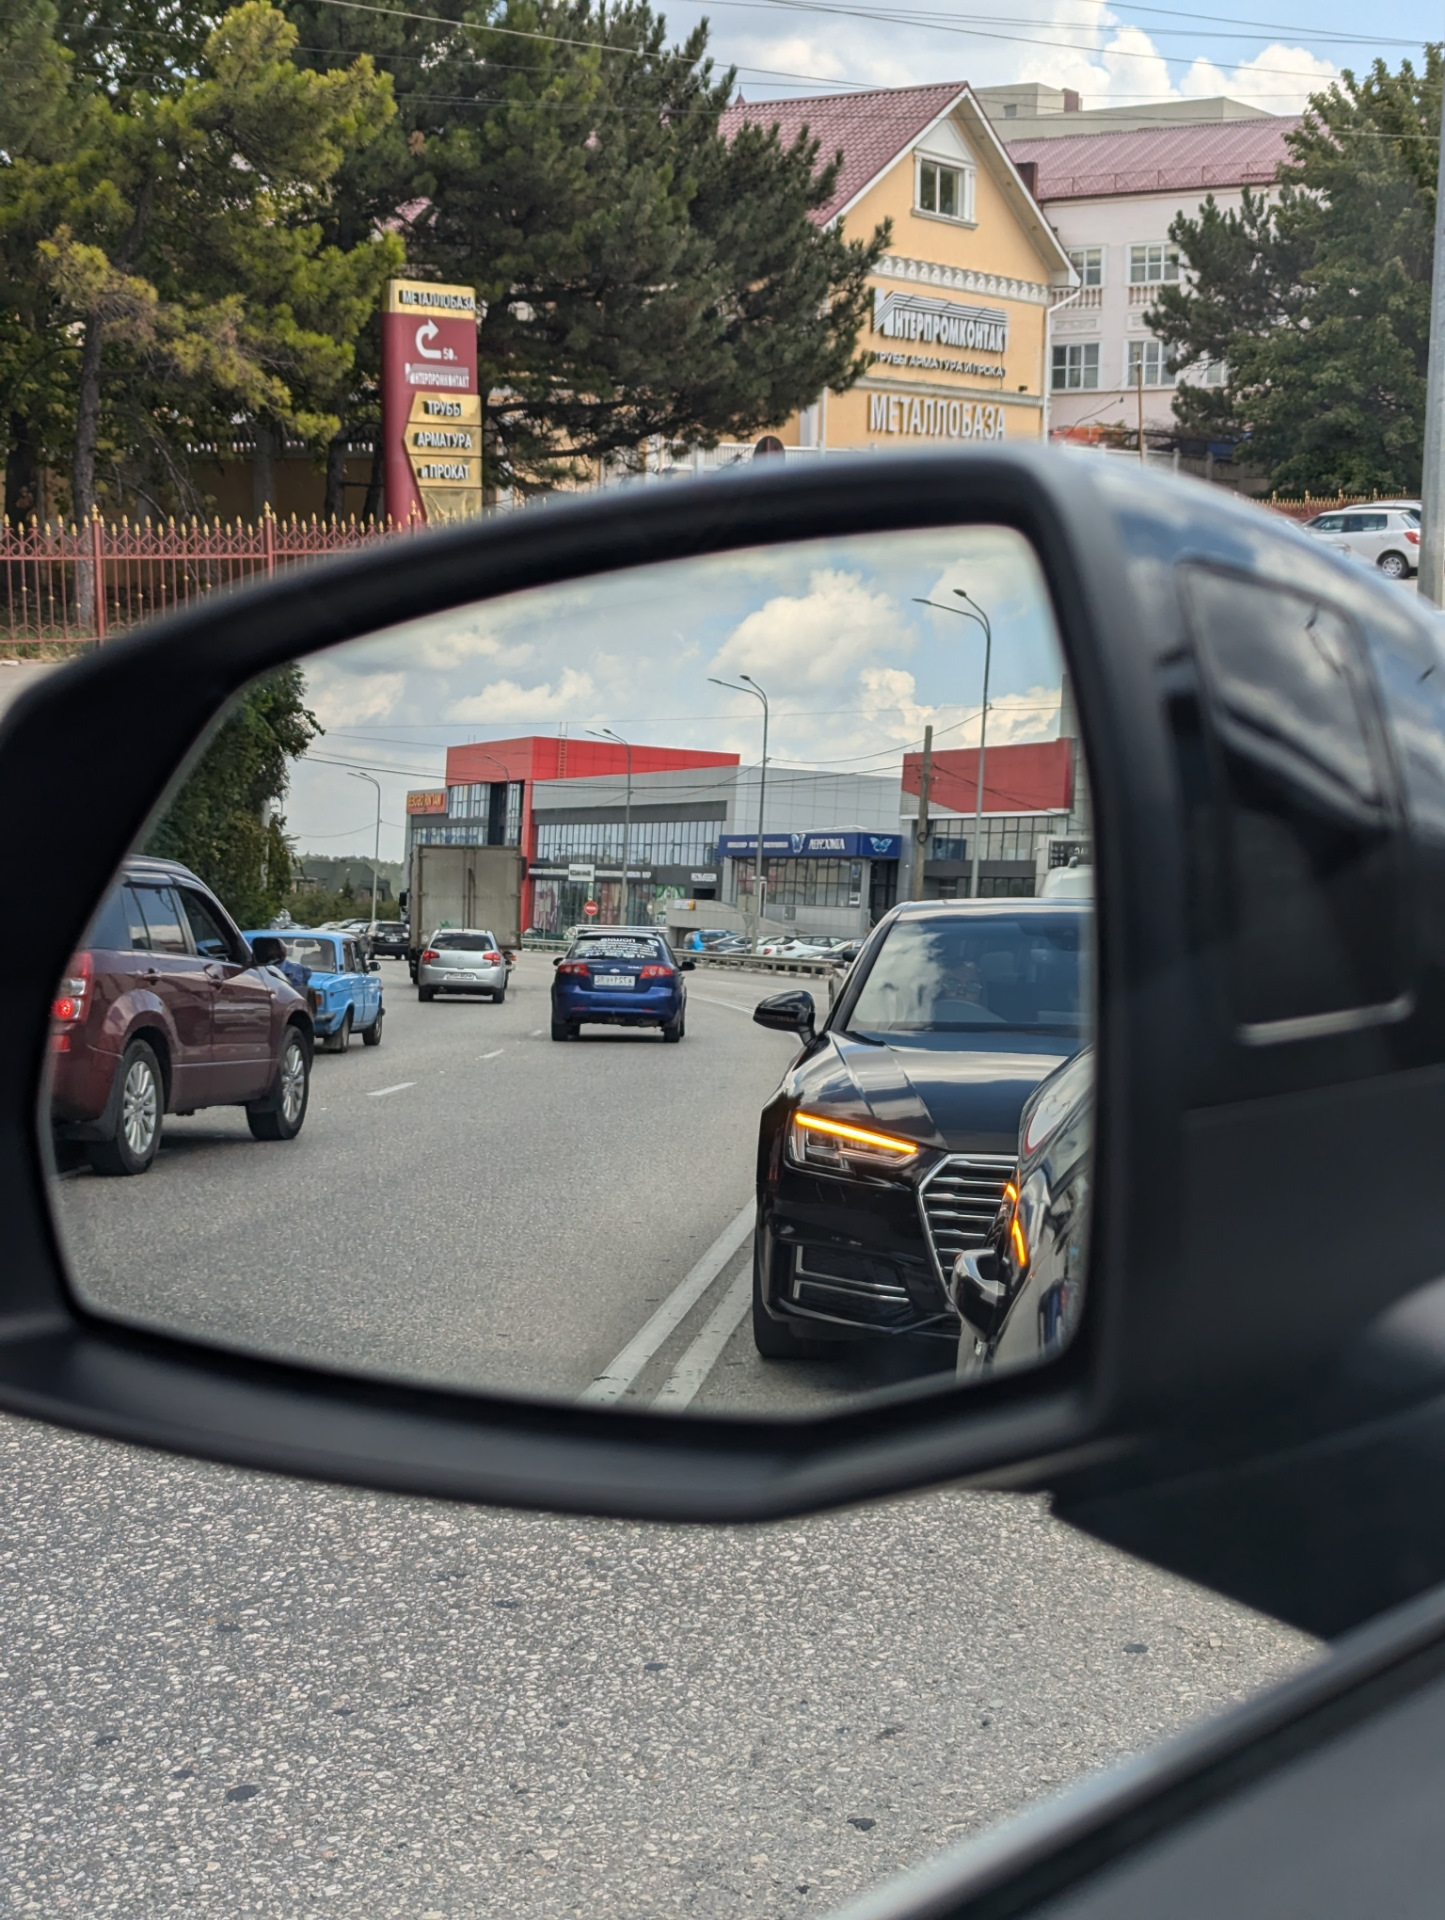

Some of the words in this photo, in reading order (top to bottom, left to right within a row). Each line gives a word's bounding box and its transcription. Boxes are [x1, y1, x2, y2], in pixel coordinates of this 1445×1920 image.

[402, 290, 476, 310] МЕТАЛЛОБАЗА
[875, 351, 908, 365] ТРУБЫ
[909, 355, 963, 372] АРМАТУРА
[427, 401, 463, 417] ТРУБЫ
[870, 393, 1006, 440] МЕТАЛЛОБАЗА
[417, 432, 472, 448] АРМАТУРА
[430, 464, 470, 479] ПРОКАТ
